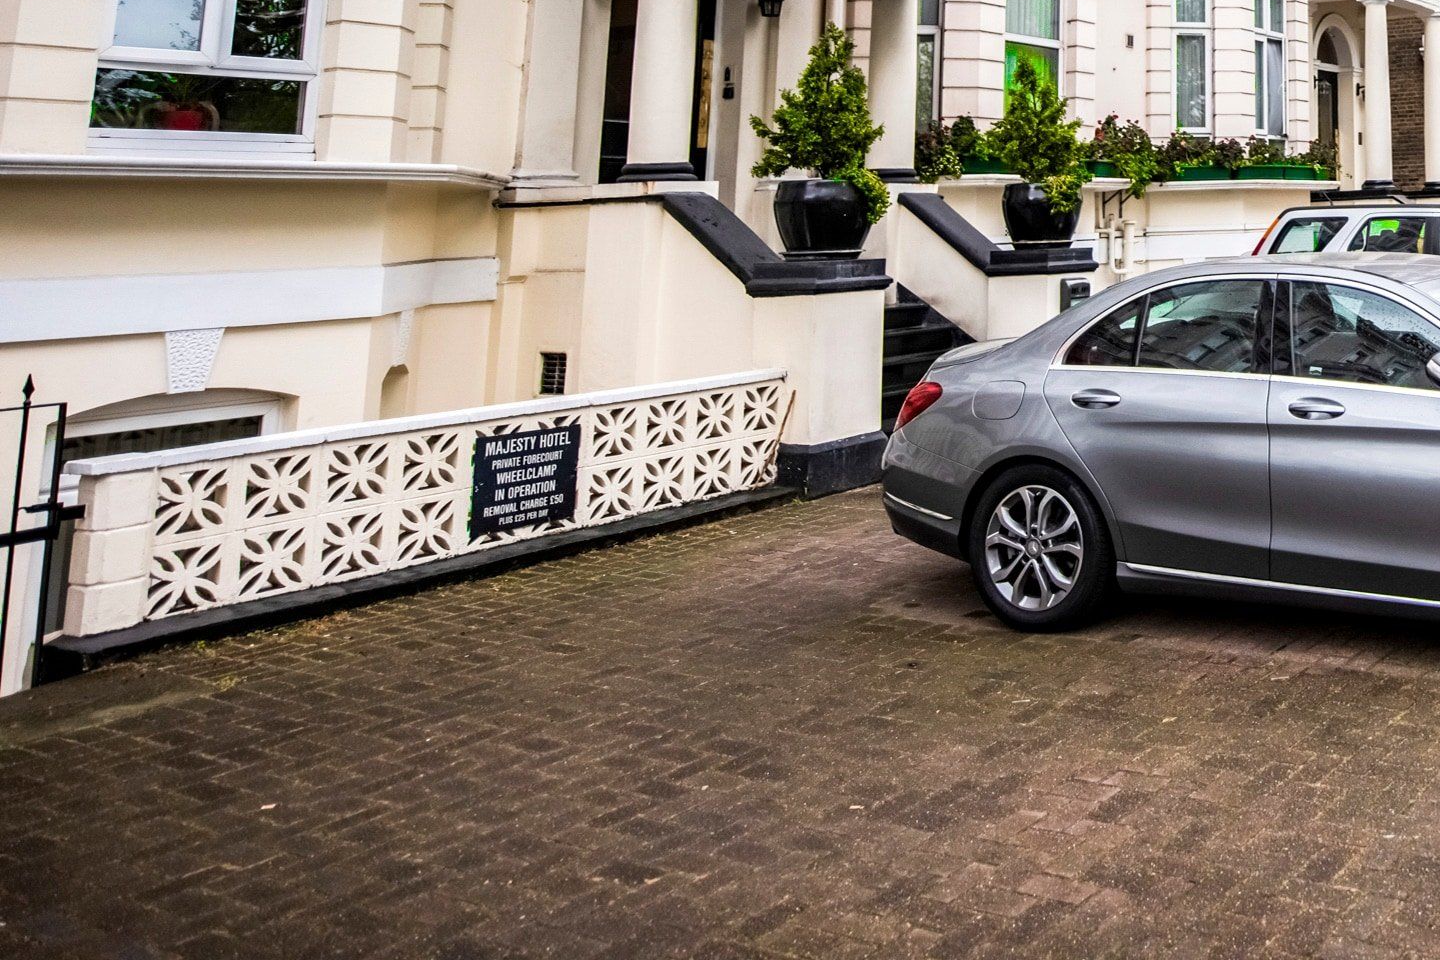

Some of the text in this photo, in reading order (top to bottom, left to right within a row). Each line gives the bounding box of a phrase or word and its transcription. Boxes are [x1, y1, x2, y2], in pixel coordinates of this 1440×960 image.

[485, 431, 571, 457] MAJESTY HOTEL
[491, 450, 564, 470] PRIVATE FORECOURT
[496, 464, 558, 485] WHEELCLAMP
[494, 480, 557, 502] IN OPERATION
[483, 494, 564, 518] REMOVAL CHARGE £50
[498, 508, 549, 526] PLUS £25 PER DAY
